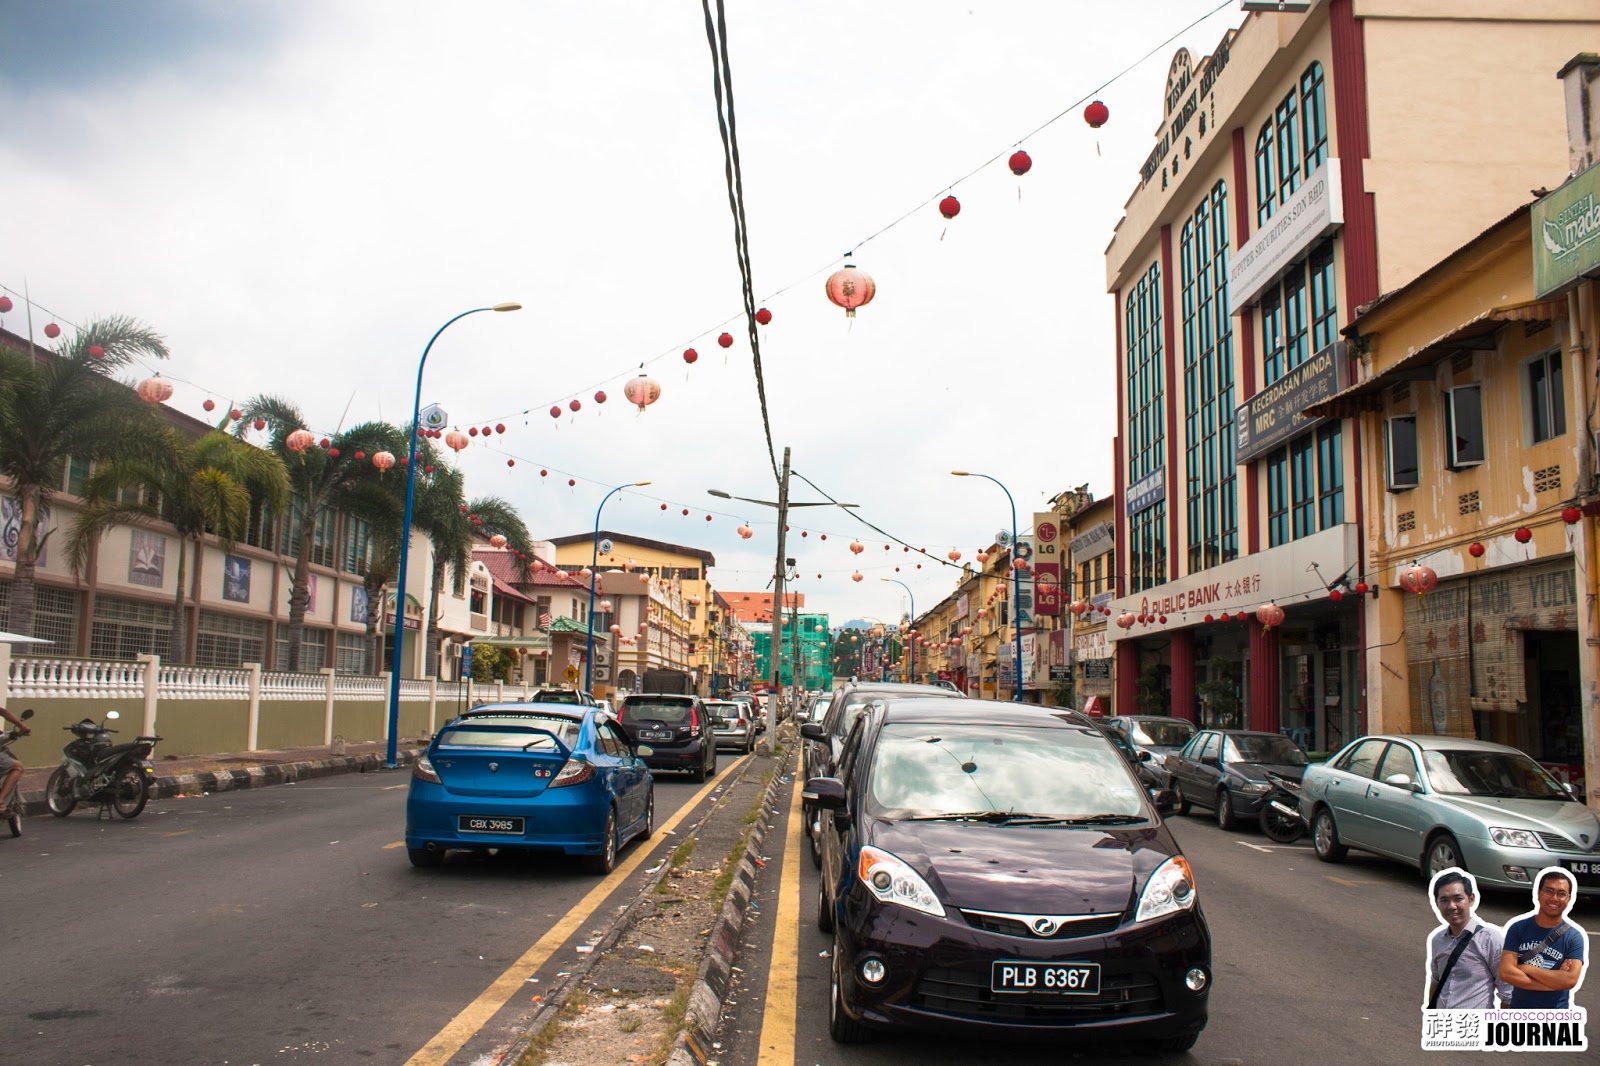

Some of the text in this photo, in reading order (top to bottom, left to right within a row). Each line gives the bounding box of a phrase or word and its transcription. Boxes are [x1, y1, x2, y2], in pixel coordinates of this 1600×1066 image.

[1167, 65, 1191, 117] WISMA
[1231, 251, 1255, 282] JUPITER
[1255, 213, 1292, 259] SECURITIES
[1293, 195, 1307, 221] SDN
[1308, 180, 1325, 206] BHD
[1251, 352, 1332, 415] KECERDASAN MINDA
[1255, 409, 1276, 435] MRC
[1039, 545, 1055, 554] LG
[1152, 582, 1220, 616] PUBLIC BANK
[1225, 574, 1261, 599] 大众银行
[1528, 568, 1577, 609] YUEN
[1039, 595, 1055, 605] LG
[470, 819, 513, 830] CBX 3985
[1571, 862, 1588, 874] WJQ
[1002, 967, 1090, 988] PLB 6367
